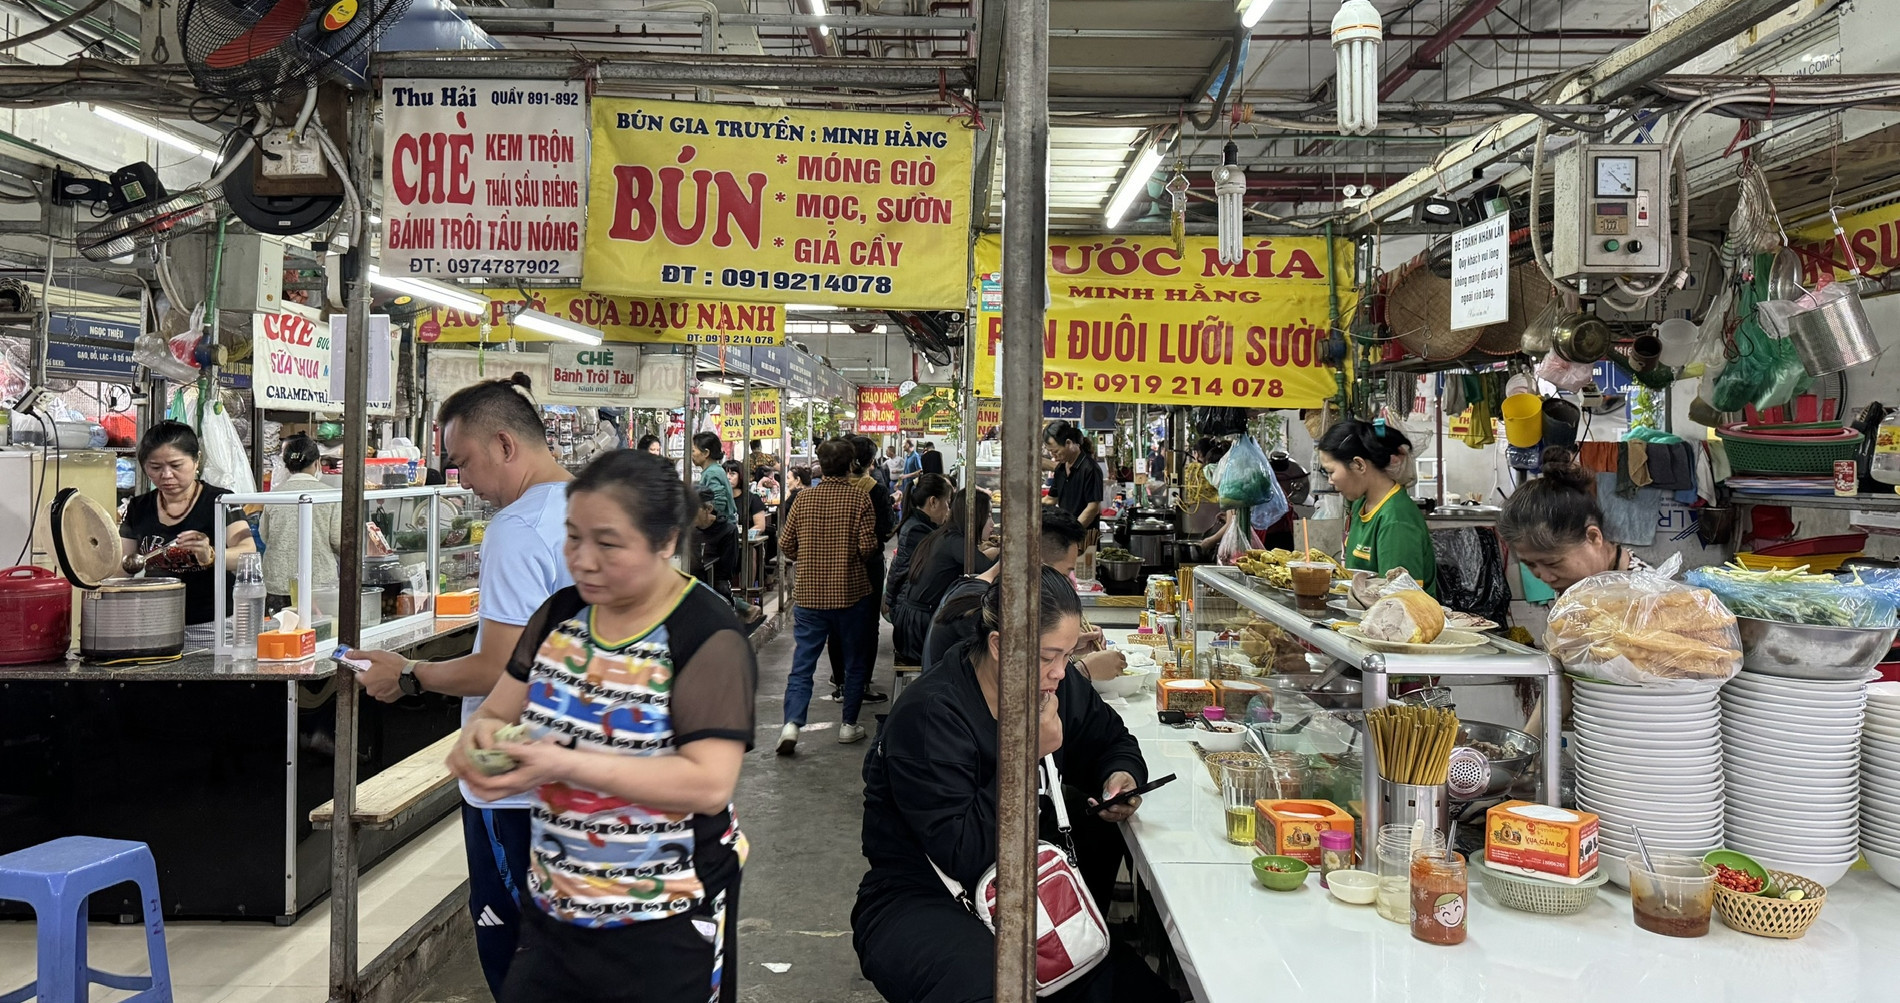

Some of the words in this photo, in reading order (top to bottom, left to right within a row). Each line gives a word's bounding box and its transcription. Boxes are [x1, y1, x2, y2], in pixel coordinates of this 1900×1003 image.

[392, 87, 434, 107] Thu
[440, 85, 477, 107] Hải
[491, 86, 524, 105] QUẦY
[528, 92, 579, 106] 891-892
[617, 109, 664, 132] BÚN
[670, 116, 709, 135] GIA
[715, 116, 805, 142] TRUYỀN
[822, 127, 879, 146] MINH
[885, 121, 947, 149] HẰNG
[392, 111, 475, 206] CHÈ
[486, 134, 522, 162] KEM
[528, 129, 574, 168] TRỘN
[797, 152, 881, 184] MÓNG
[890, 155, 936, 186] GIÒ
[486, 172, 512, 207] THÁI
[515, 169, 539, 207] SẦU
[542, 173, 578, 208] RIÊNG
[608, 145, 768, 250] BÚN
[796, 193, 867, 226] MỌC,
[876, 192, 952, 225] SƯỜN
[389, 212, 435, 250] BÁNH
[441, 212, 482, 251] TRÔI
[488, 210, 522, 252] TẦU
[528, 214, 579, 252] NÓNG
[794, 229, 841, 265] GIẢ
[850, 233, 904, 267] CẦY
[1049, 237, 1182, 277] ƯỚC
[1200, 240, 1325, 279] MÍA
[409, 258, 441, 273] ĐT:
[448, 258, 560, 274] 0974787902
[721, 268, 892, 294] 0919214078
[1068, 285, 1155, 301] MINH
[1164, 283, 1262, 304] HẰNG
[568, 291, 621, 326] SỮA
[629, 297, 689, 334] ĐẬU
[89, 325, 107, 338] NGỌC
[107, 328, 124, 340] THIỆU
[687, 333, 702, 343] ĐT:
[705, 334, 730, 344] 0919
[733, 335, 752, 344] 214
[755, 336, 774, 345] 078
[1067, 313, 1148, 363] ĐUÔI
[1159, 315, 1234, 366] LƯỠI
[576, 348, 614, 366] CHÈ
[554, 367, 583, 383] Bánh
[586, 368, 609, 384] Trôi
[613, 369, 634, 385] Tàu
[1044, 371, 1083, 391] ĐT:
[1093, 373, 1162, 394] 0919
[1171, 376, 1223, 396] 214
[1232, 378, 1284, 398] 078
[724, 399, 743, 417] BÁNH
[860, 388, 880, 404] CHÁO
[880, 388, 897, 405] LÒNG
[862, 406, 877, 422] BÚN
[877, 407, 896, 422] LÒNG
[1050, 406, 1074, 416] MỌC
